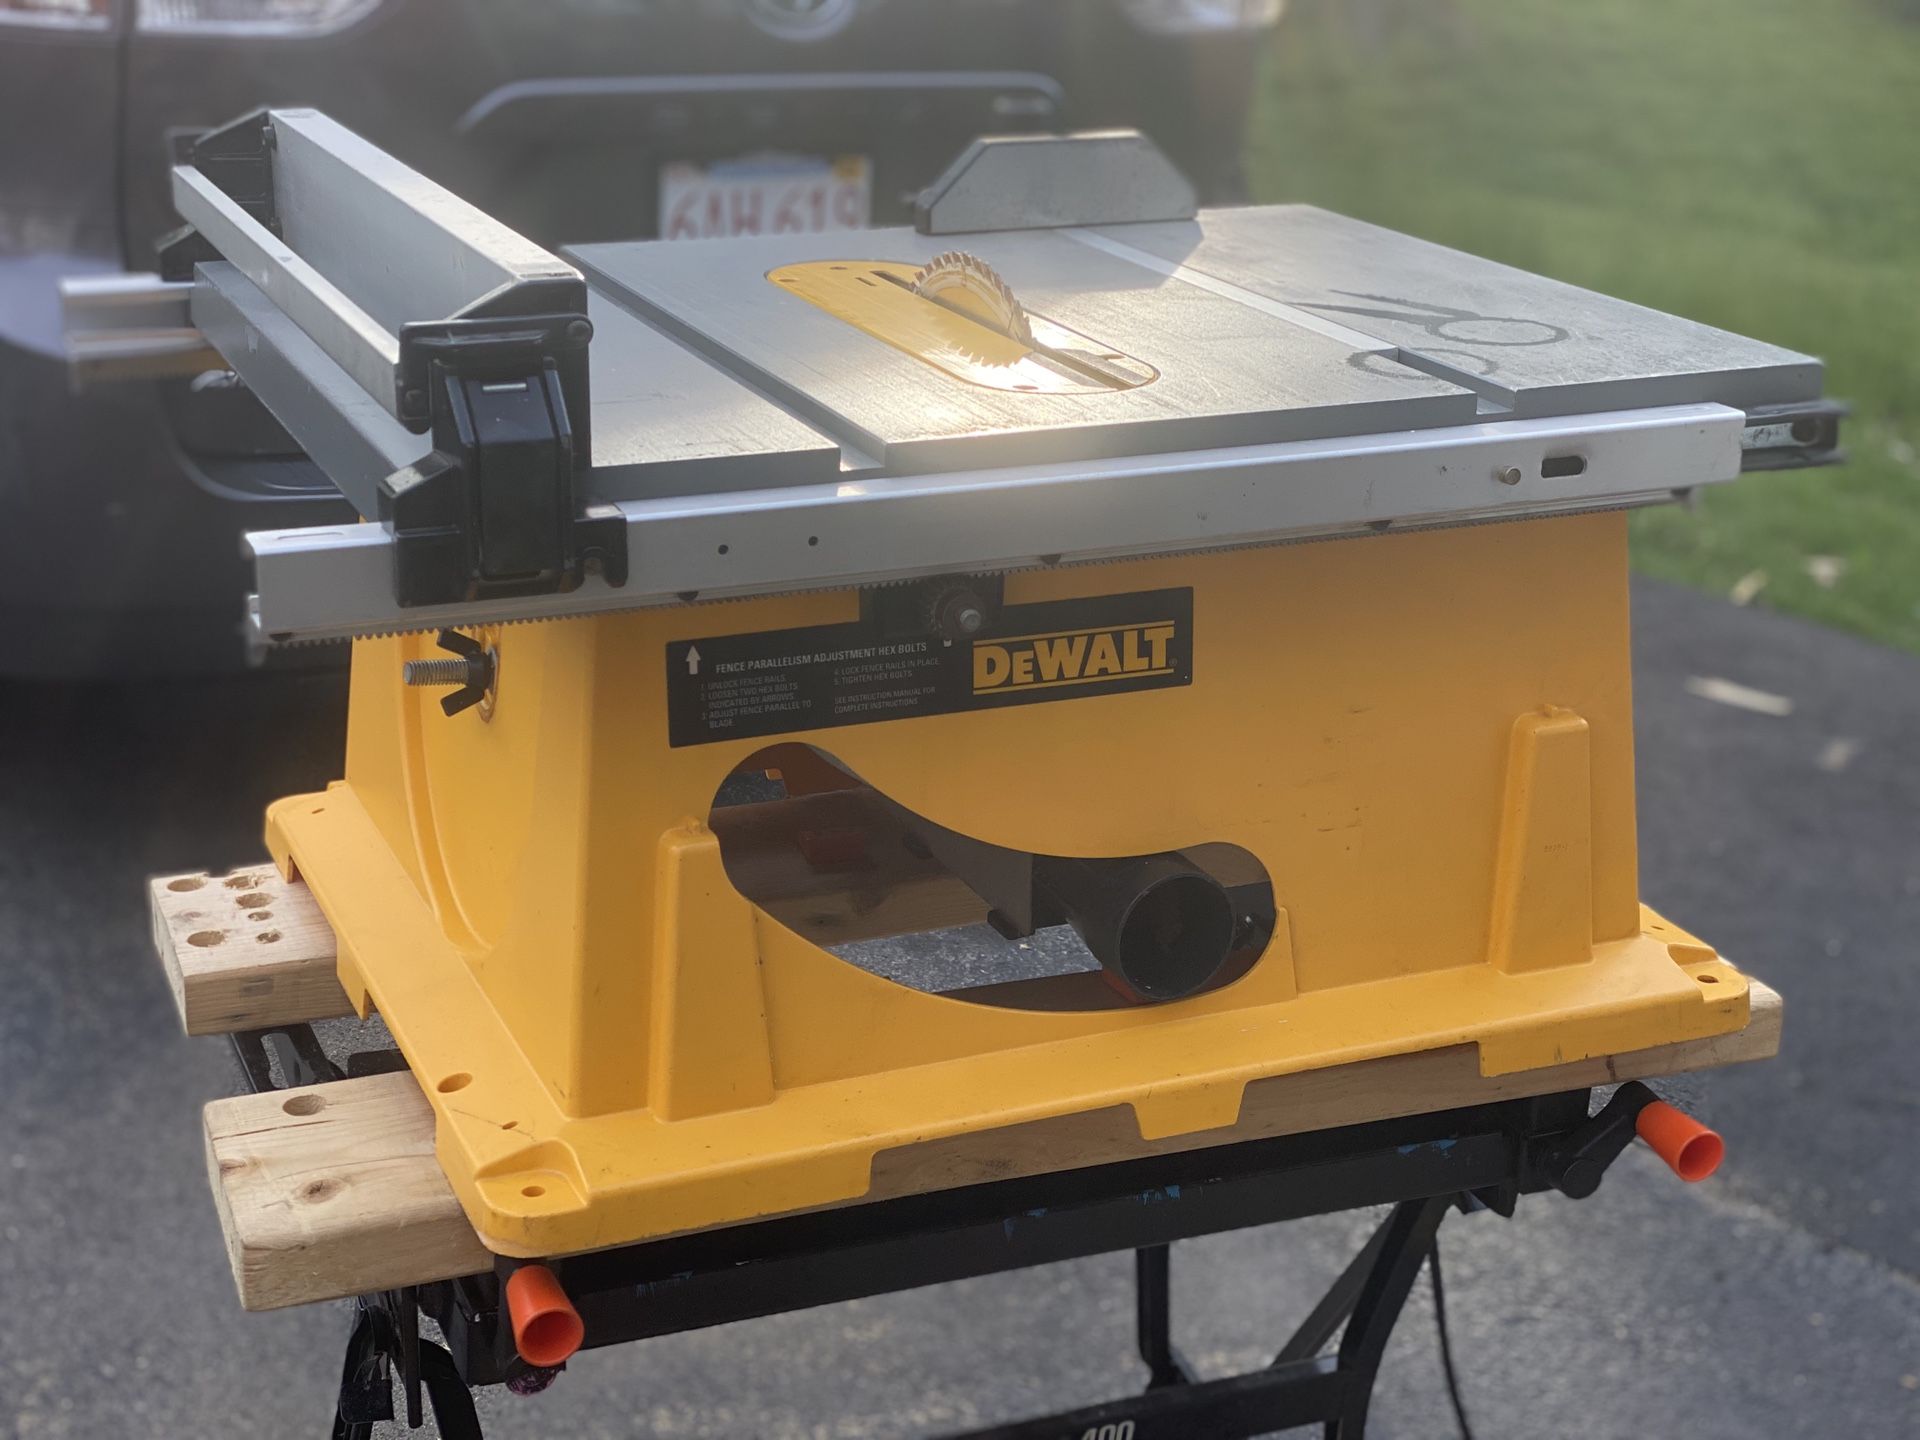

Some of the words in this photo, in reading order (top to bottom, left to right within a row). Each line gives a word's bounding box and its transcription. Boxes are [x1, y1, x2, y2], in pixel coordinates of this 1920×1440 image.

[716, 662, 745, 674] FENCE
[747, 654, 811, 670] PARALLELISM
[813, 648, 876, 662] ADJUSTMENT
[878, 645, 896, 656] HEX
[898, 642, 927, 654] BOLTS
[841, 666, 860, 676] LOCK
[861, 663, 884, 673] FENCE
[885, 661, 906, 670] RAILS
[907, 660, 915, 668] IN
[708, 680, 738, 690] UNLOCK
[740, 677, 763, 687] FENCE
[841, 674, 873, 685] TIGHTEN
[874, 672, 888, 681] HEX
[708, 690, 738, 700] LOOSEN
[740, 687, 757, 696] TWO
[758, 685, 774, 694] HEX
[775, 682, 798, 692] BOLTS
[834, 696, 847, 705] SEE
[848, 691, 893, 703] INSTRUCTION
[893, 688, 921, 698] MANUAL
[922, 686, 936, 695] FOR
[708, 698, 749, 710] INDICATED
[750, 696, 760, 705] BY
[709, 709, 738, 719] ADJUST
[740, 706, 763, 715] FENCE
[764, 702, 800, 712] PARALLEL
[802, 699, 812, 708] TO
[834, 703, 868, 714] COMPLETE
